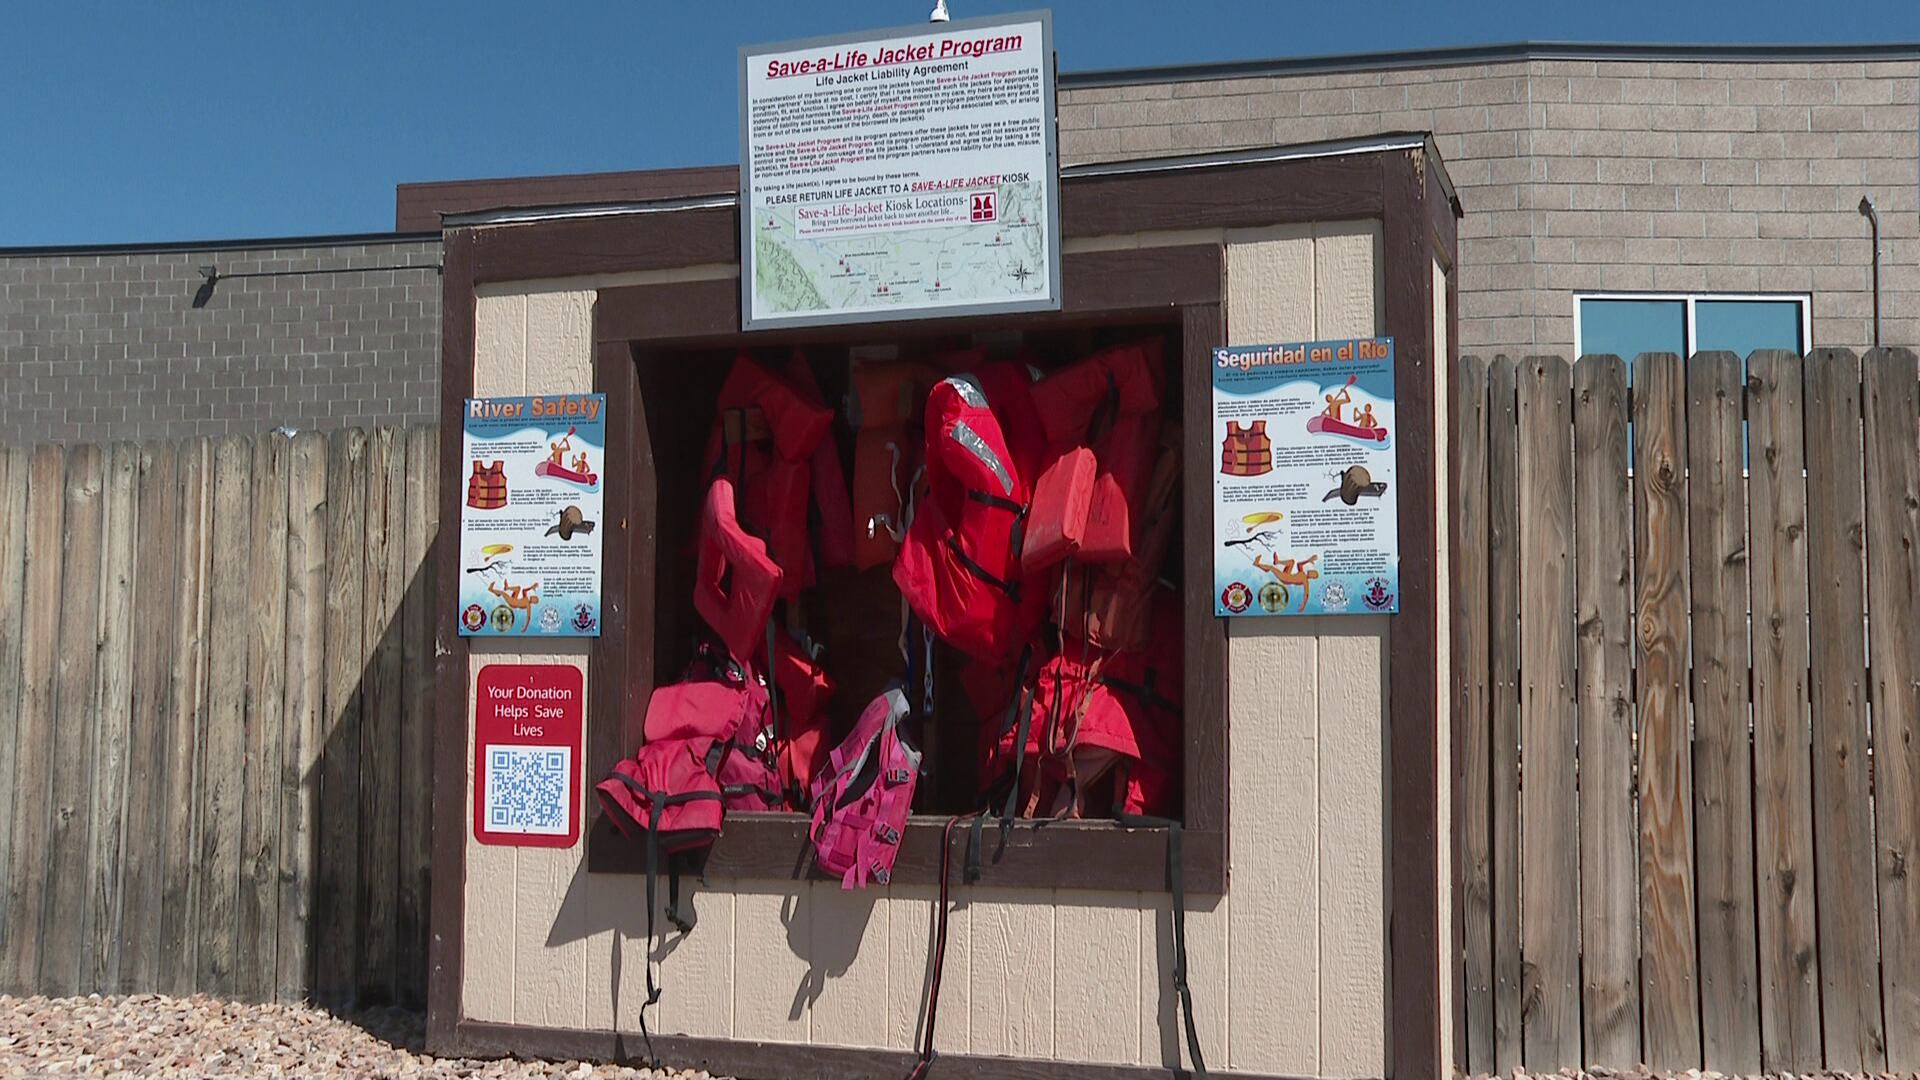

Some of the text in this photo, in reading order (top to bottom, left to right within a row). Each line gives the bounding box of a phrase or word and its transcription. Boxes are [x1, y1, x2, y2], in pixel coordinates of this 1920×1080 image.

[767, 35, 1022, 77] Save-a-Life Jacket Program
[815, 61, 968, 86] Life Jacket Liability Agreement
[765, 172, 1029, 204] PLEASE RETURN LIFE JACKET TO A SAVE-A-LIFE JACKET KIOSK
[798, 201, 882, 219] Save-a-Life-Jacket
[885, 198, 912, 211] Kiosk
[1217, 345, 1305, 370] Seguridad
[1310, 349, 1332, 362] en
[1337, 342, 1353, 360] el
[470, 396, 601, 421] River Safety
[488, 686, 572, 700] Your Donation
[495, 705, 564, 720] Helps Save
[514, 723, 543, 736] Lives
